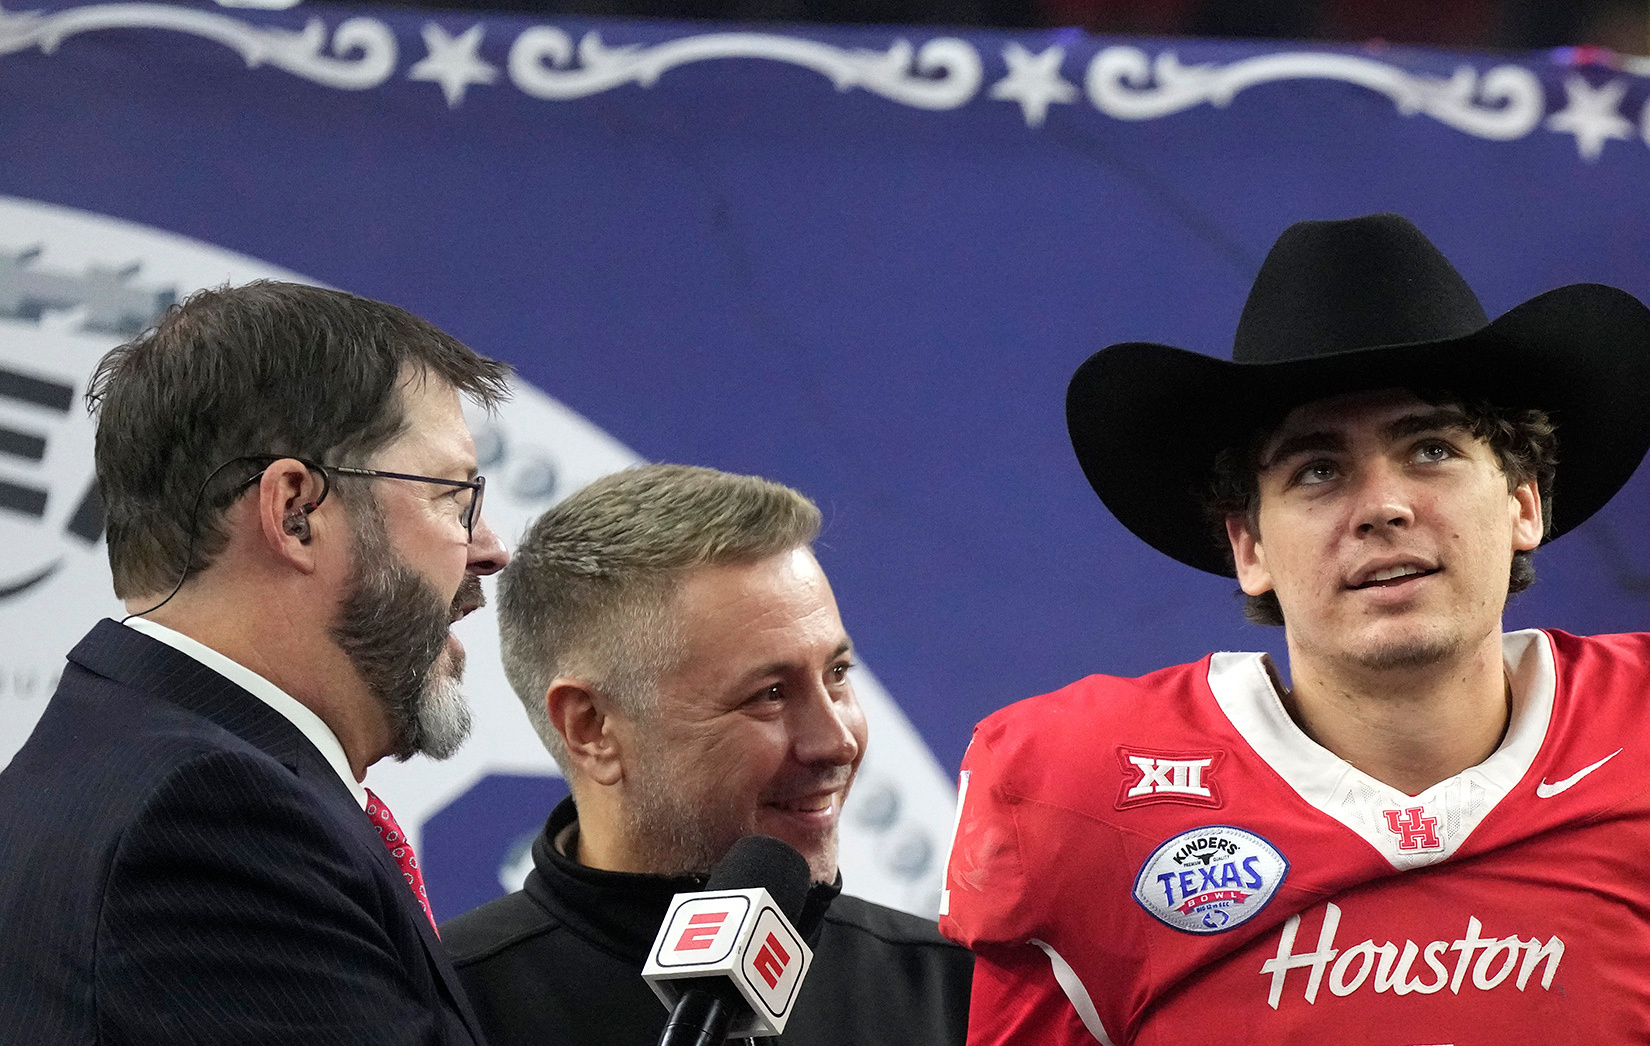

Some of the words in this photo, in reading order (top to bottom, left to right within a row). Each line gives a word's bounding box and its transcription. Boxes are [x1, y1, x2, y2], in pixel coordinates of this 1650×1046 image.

[1128, 756, 1213, 797] XII
[1173, 837, 1237, 864] KINDER'S
[1157, 856, 1263, 907] TEXAS
[1187, 891, 1237, 907] BOWL
[1259, 902, 1565, 1010] Houston
